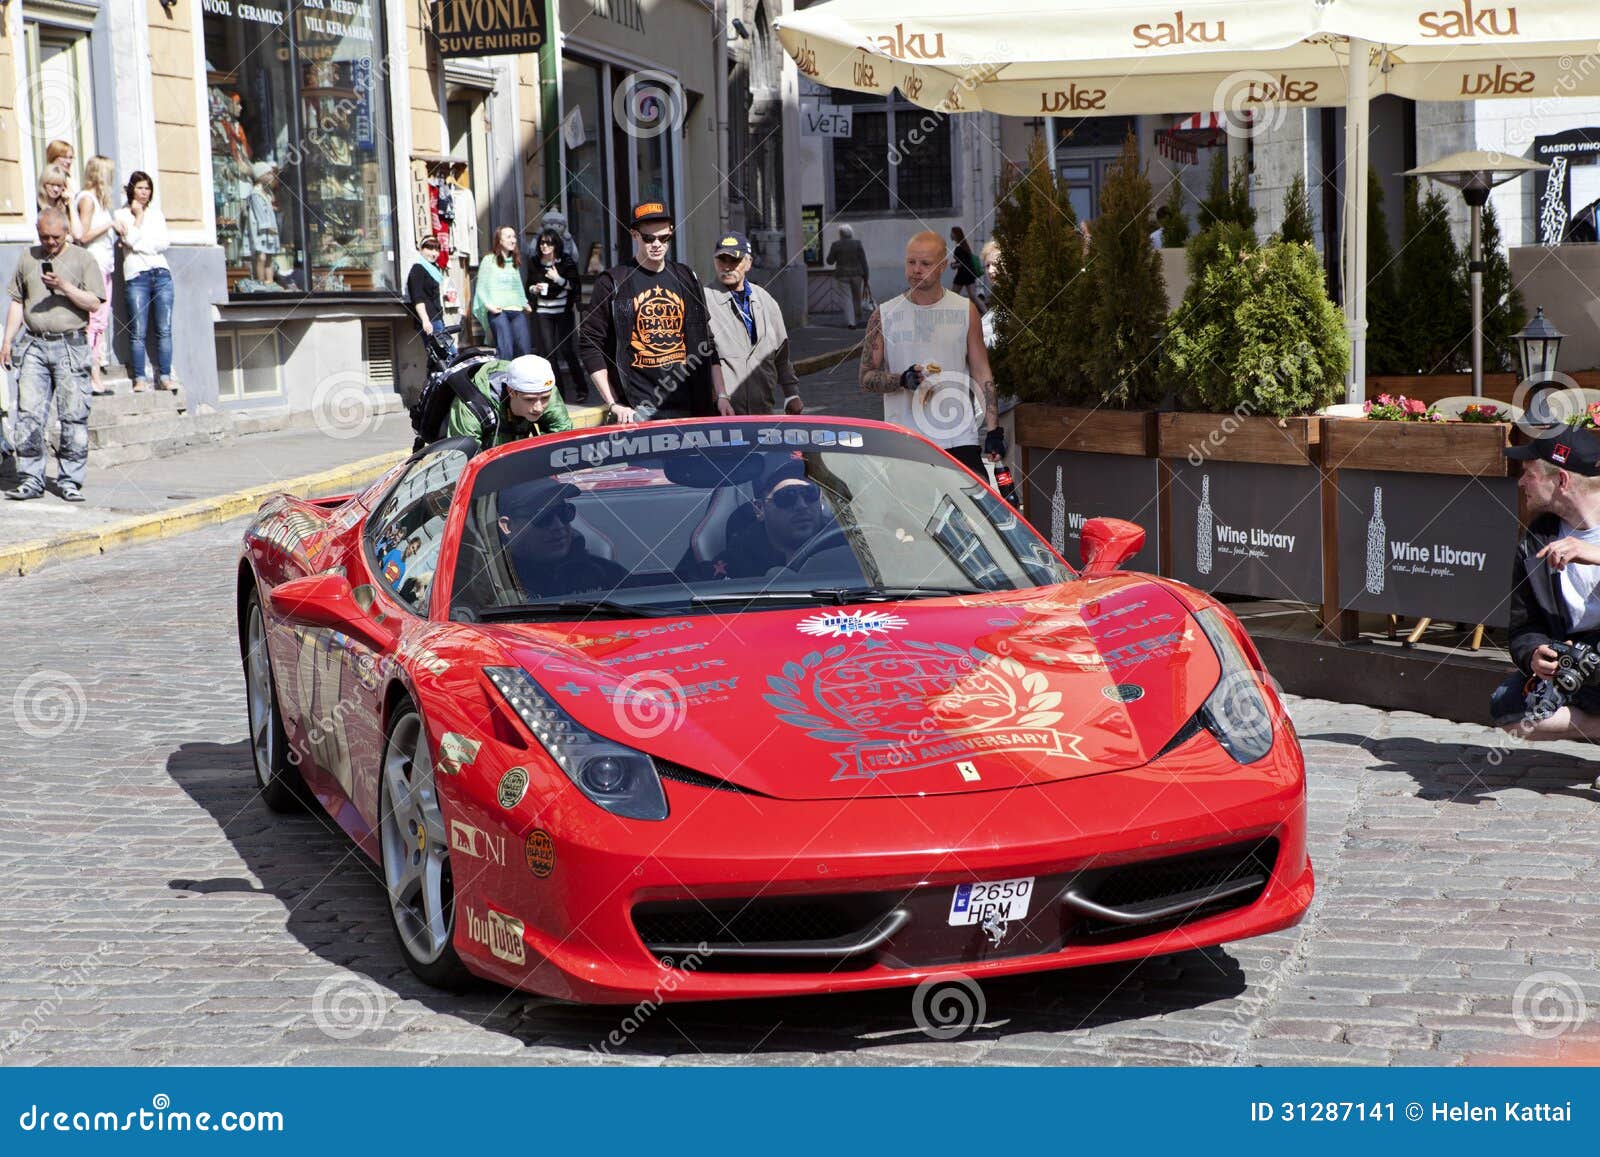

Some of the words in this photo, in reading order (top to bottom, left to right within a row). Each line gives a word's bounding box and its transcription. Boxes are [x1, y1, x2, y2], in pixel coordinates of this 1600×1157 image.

[203, 0, 233, 17] WOOL
[238, 4, 284, 26] CERAMICS
[304, 16, 325, 32] VILL
[438, 0, 540, 34] LIVONIA
[1418, 0, 1520, 38] saku
[440, 32, 542, 53] SUVENIIRID
[1132, 10, 1227, 49] saku
[1540, 143, 1577, 154] GASTRO
[640, 304, 678, 317] GUM
[549, 428, 751, 468] GUMBALL
[757, 427, 864, 448] 3000
[1216, 525, 1248, 545] Wine
[1250, 528, 1296, 553] Library
[1390, 541, 1430, 562] Wine
[1433, 544, 1487, 571] Library
[919, 732, 1049, 761] ANNIVERSARY
[473, 829, 506, 867] CNI
[971, 880, 1029, 902] 2650
[466, 905, 523, 958] YouTube
